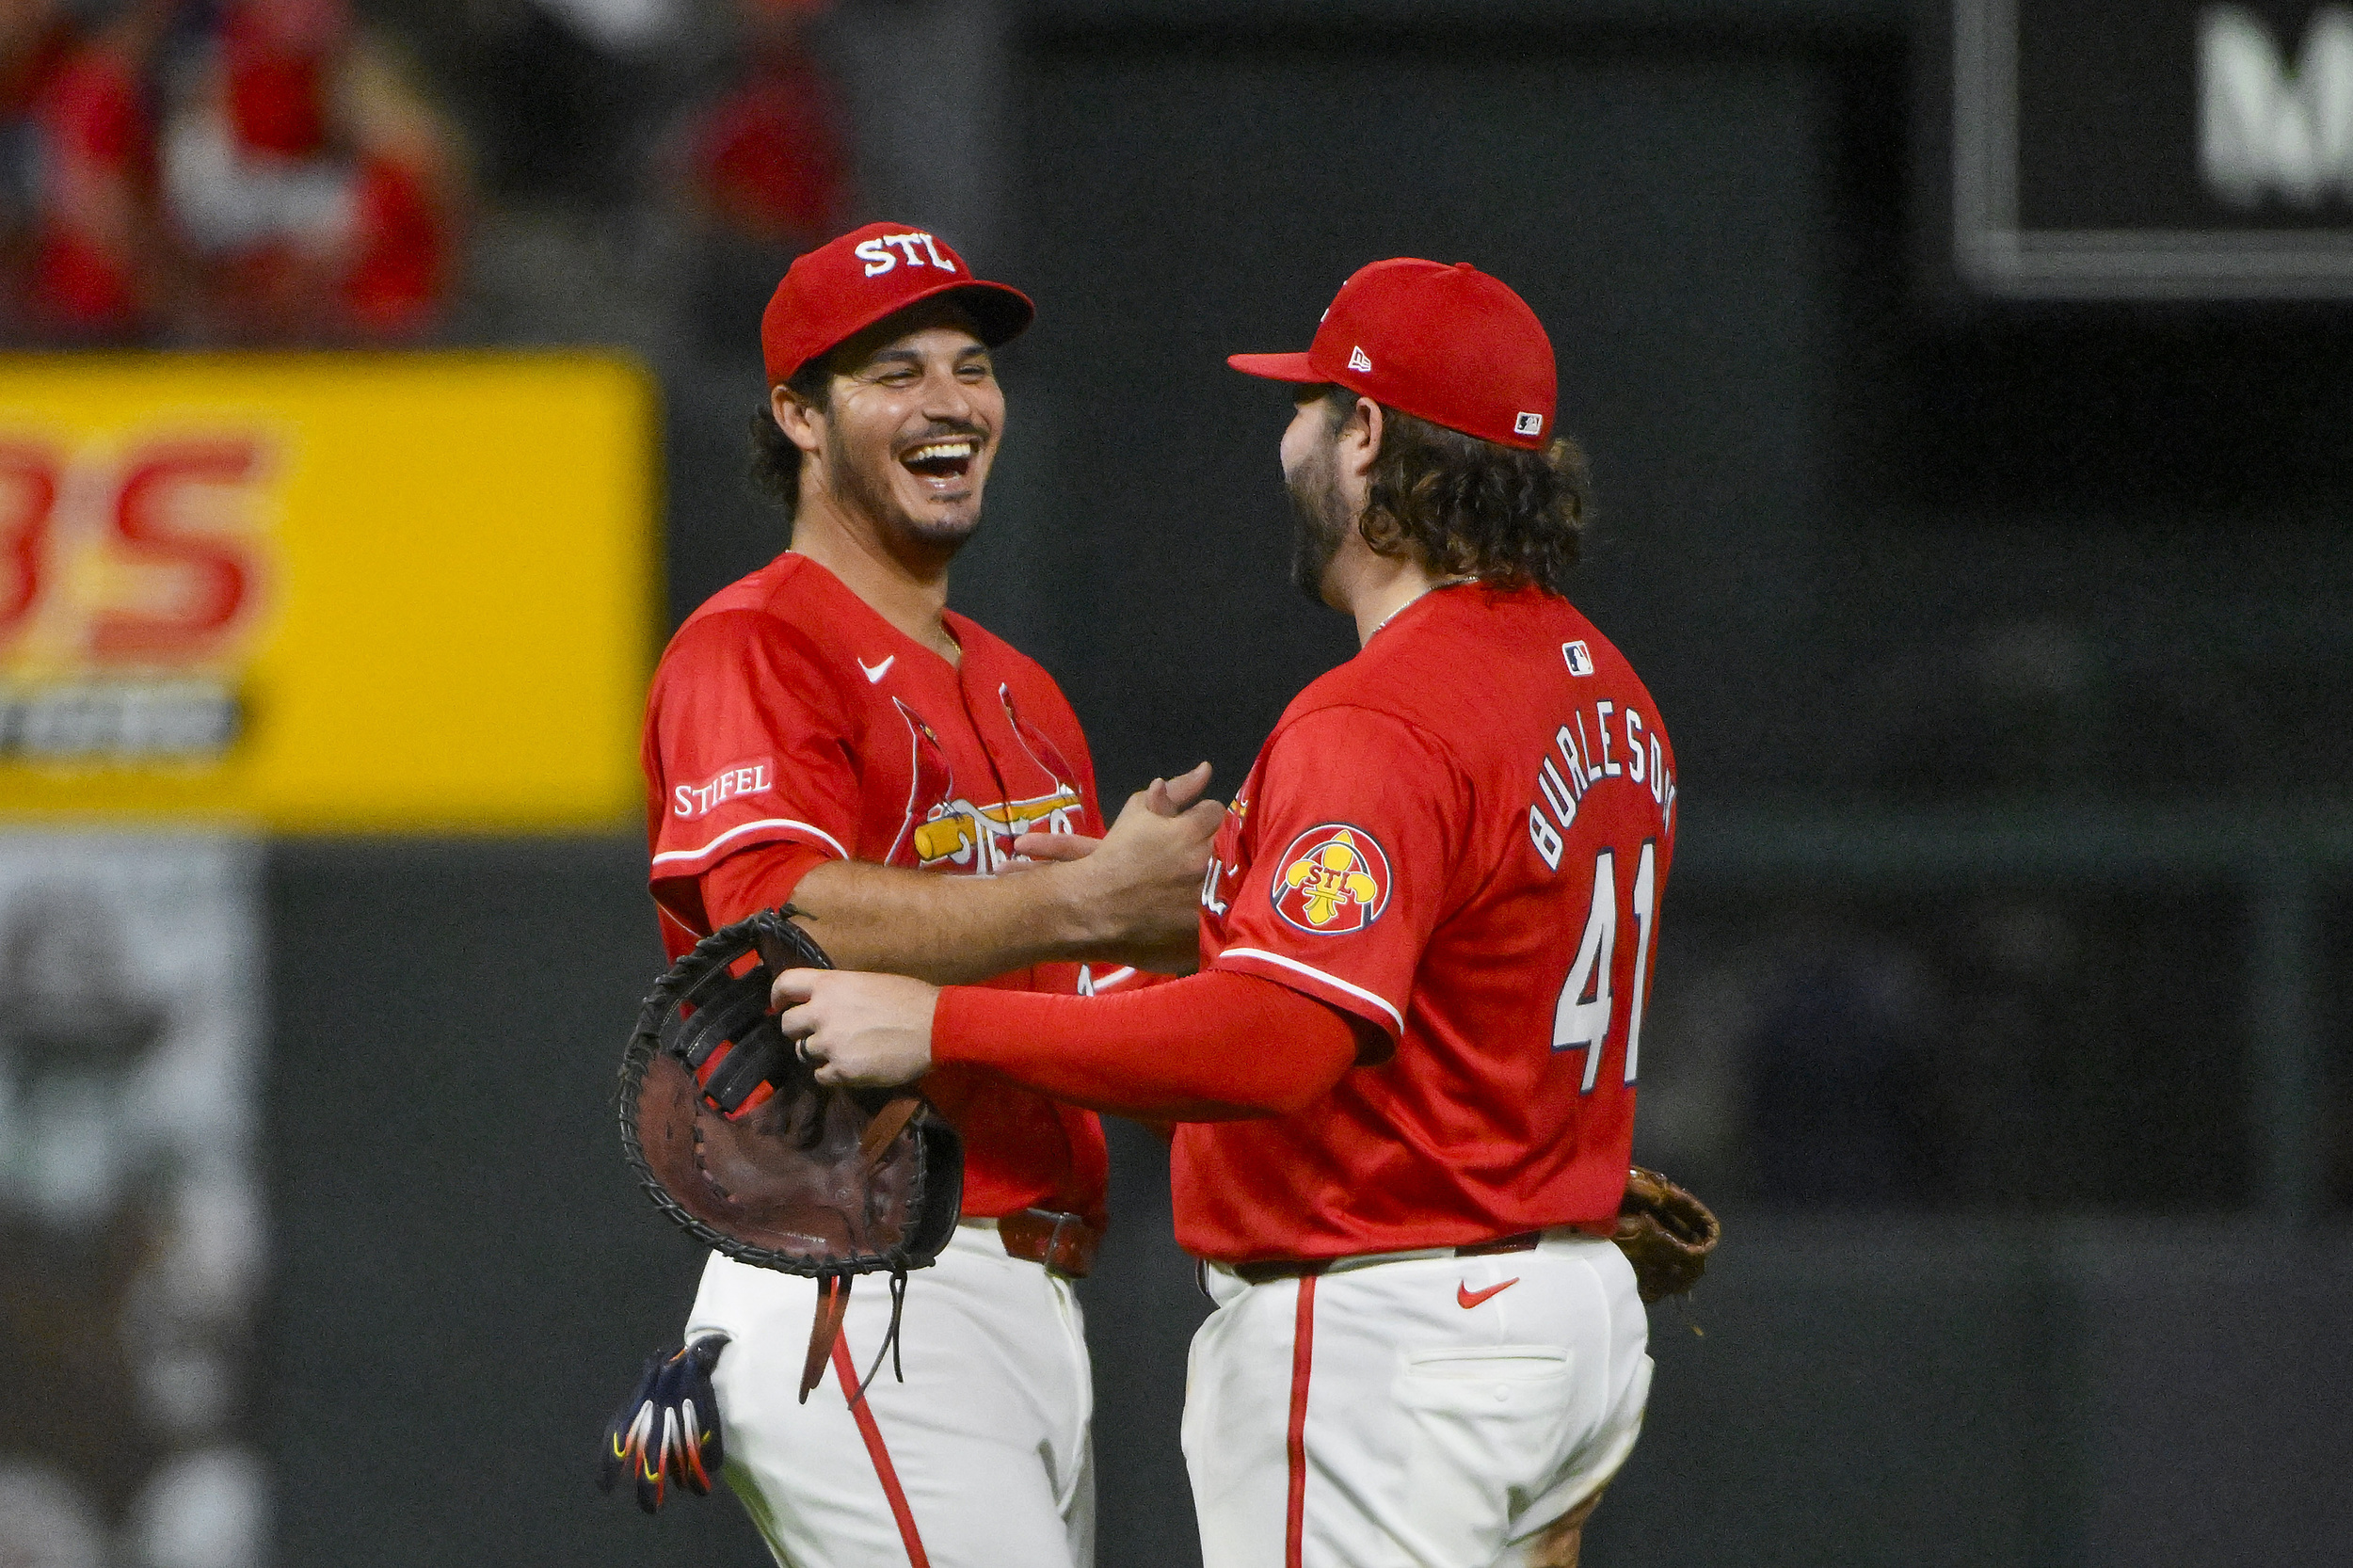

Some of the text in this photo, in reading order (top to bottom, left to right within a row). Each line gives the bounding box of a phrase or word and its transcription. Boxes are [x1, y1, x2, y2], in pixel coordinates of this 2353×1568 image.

[855, 232, 956, 279] STL
[674, 764, 772, 816] STIFEL
[1304, 863, 1353, 896] STL
[1551, 836, 1657, 1096] 41
